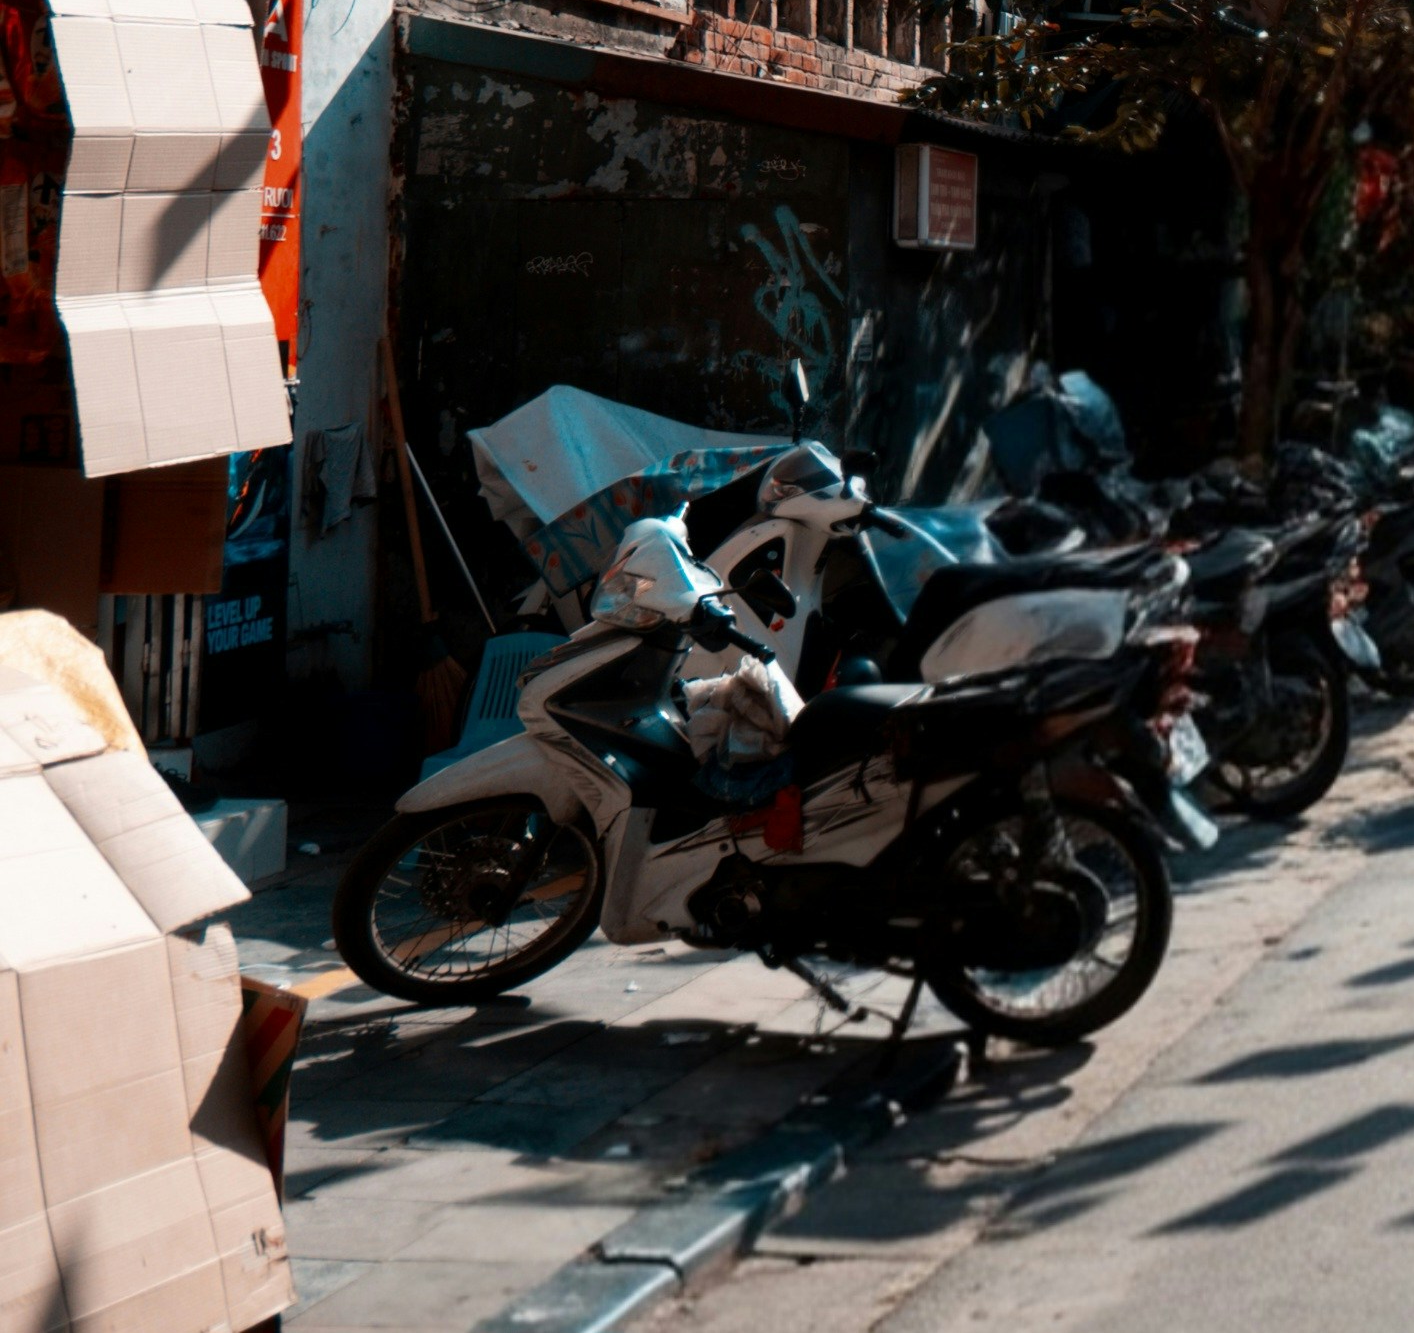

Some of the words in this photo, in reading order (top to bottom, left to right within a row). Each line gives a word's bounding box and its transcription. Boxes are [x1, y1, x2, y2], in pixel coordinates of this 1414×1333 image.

[207, 599, 243, 630] LEVEL
[243, 594, 262, 621] UP
[206, 624, 240, 655] YOUR
[240, 616, 274, 647] GAME
